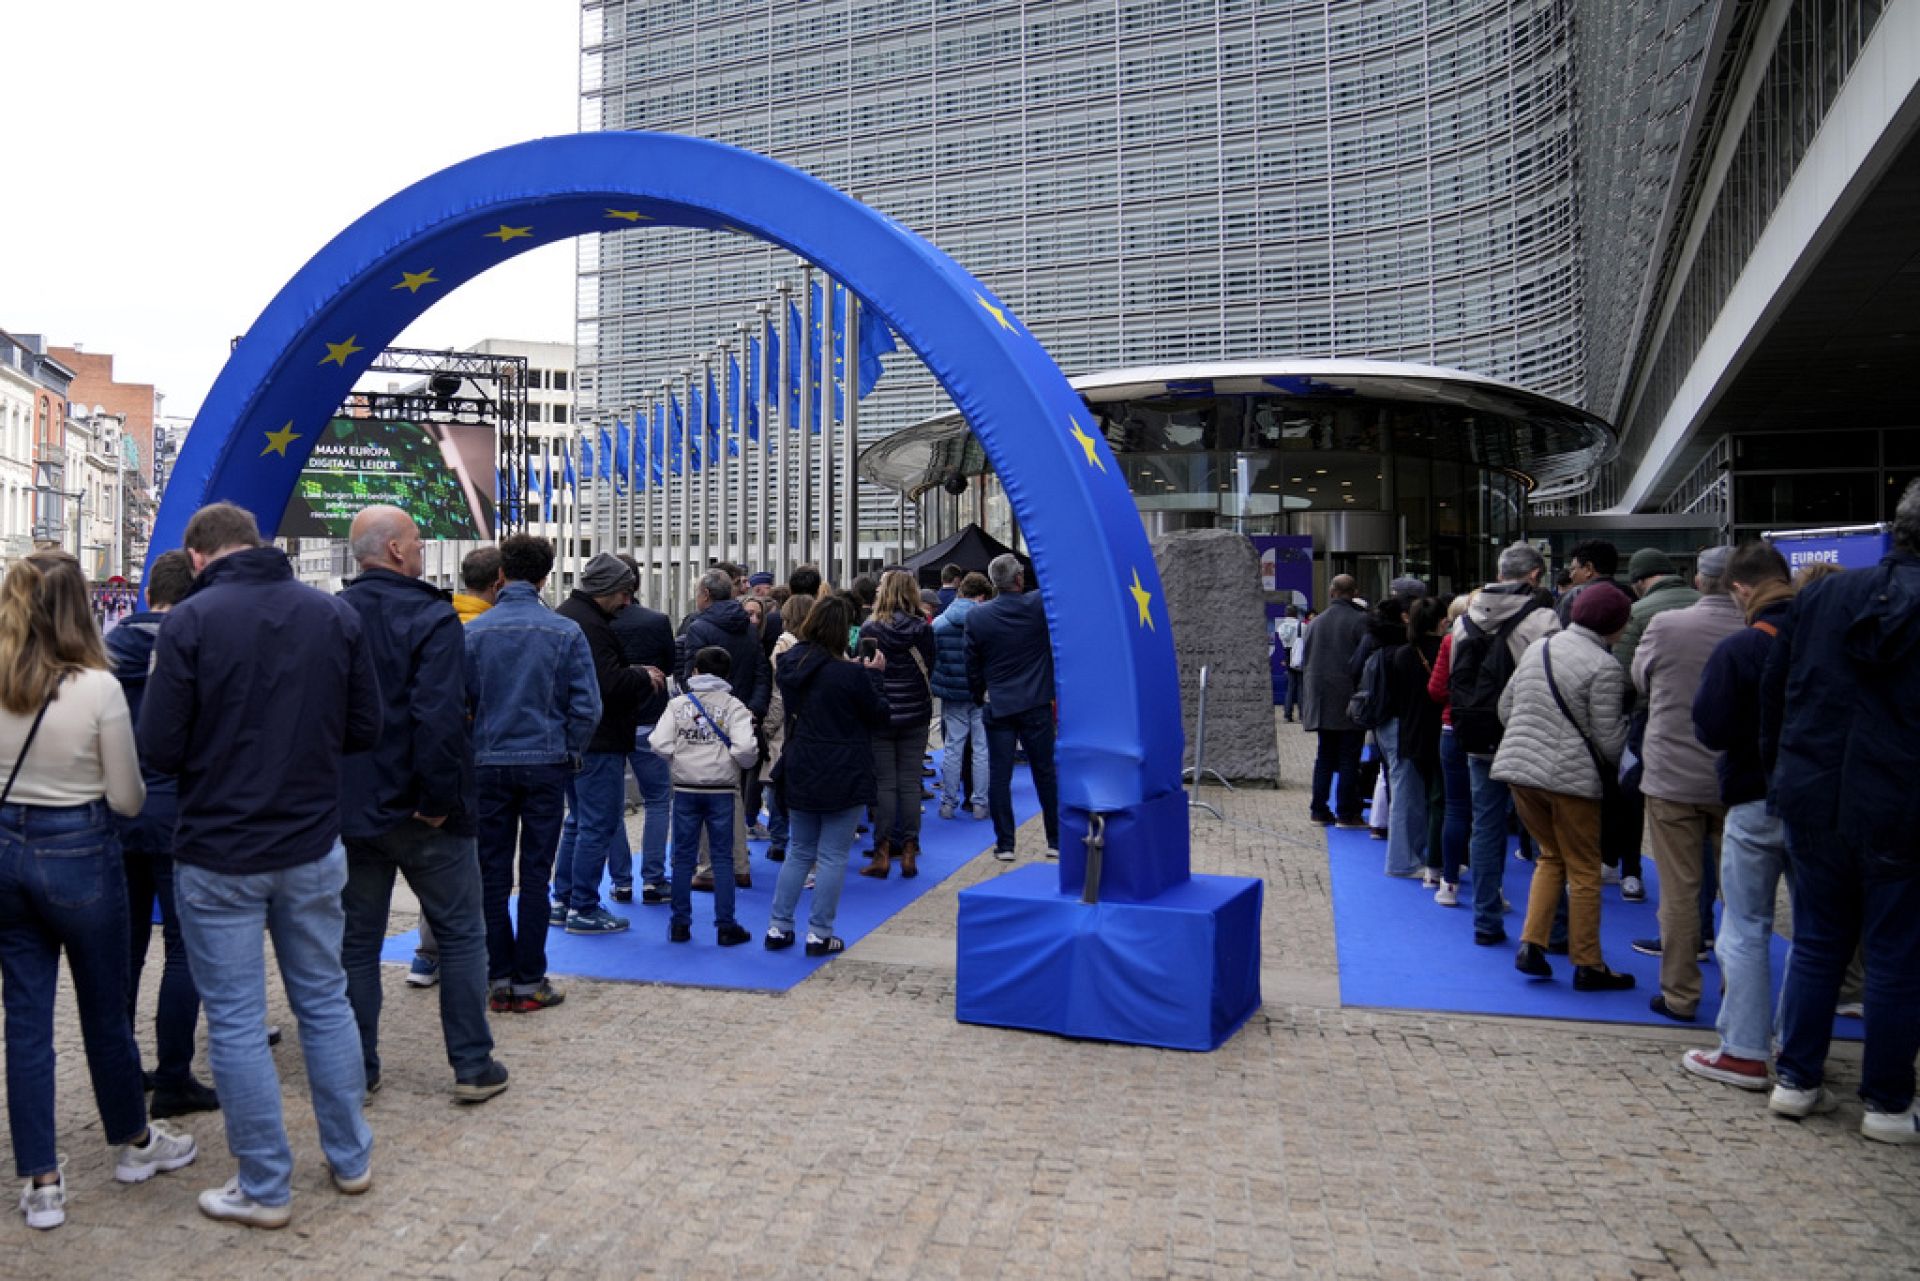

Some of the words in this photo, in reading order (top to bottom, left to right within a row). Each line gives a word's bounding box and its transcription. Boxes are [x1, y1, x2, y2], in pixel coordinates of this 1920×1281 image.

[316, 444, 346, 455] MAAK
[349, 446, 391, 457] EUROPA
[308, 457, 357, 469] DIGITAAL
[360, 459, 398, 470] LEIDER
[1791, 550, 1838, 565] EUROPE
